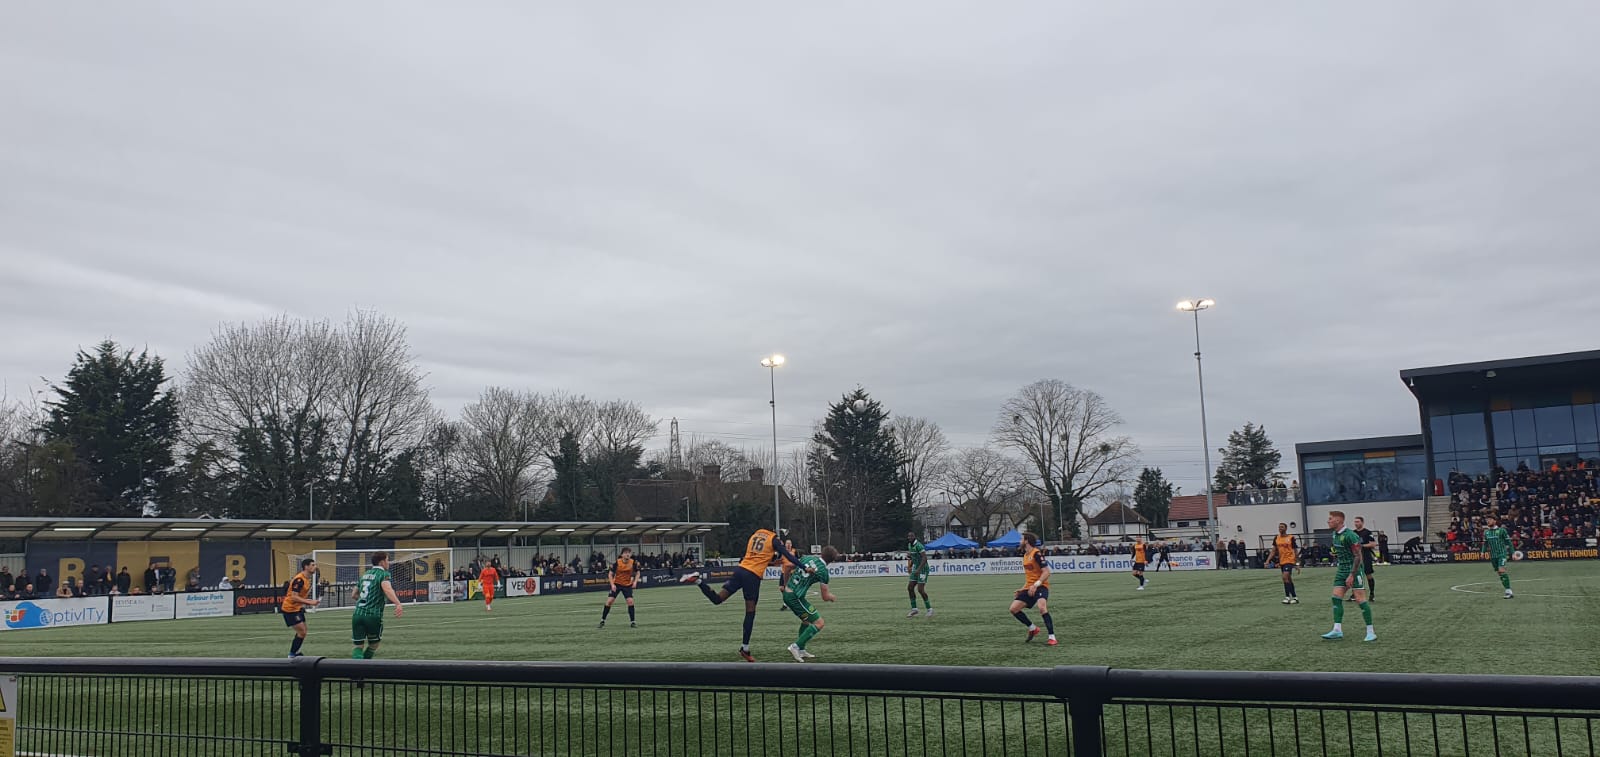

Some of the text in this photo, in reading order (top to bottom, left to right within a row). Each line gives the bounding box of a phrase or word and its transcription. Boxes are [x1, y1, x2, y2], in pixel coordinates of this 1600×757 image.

[751, 537, 766, 552] 16
[1527, 549, 1598, 559] SERVE WITH HONOUR
[225, 554, 247, 582] B
[943, 562, 985, 573] finance?
[1078, 560, 1097, 569] car
[359, 580, 371, 599] 3
[510, 579, 536, 591] VERUS
